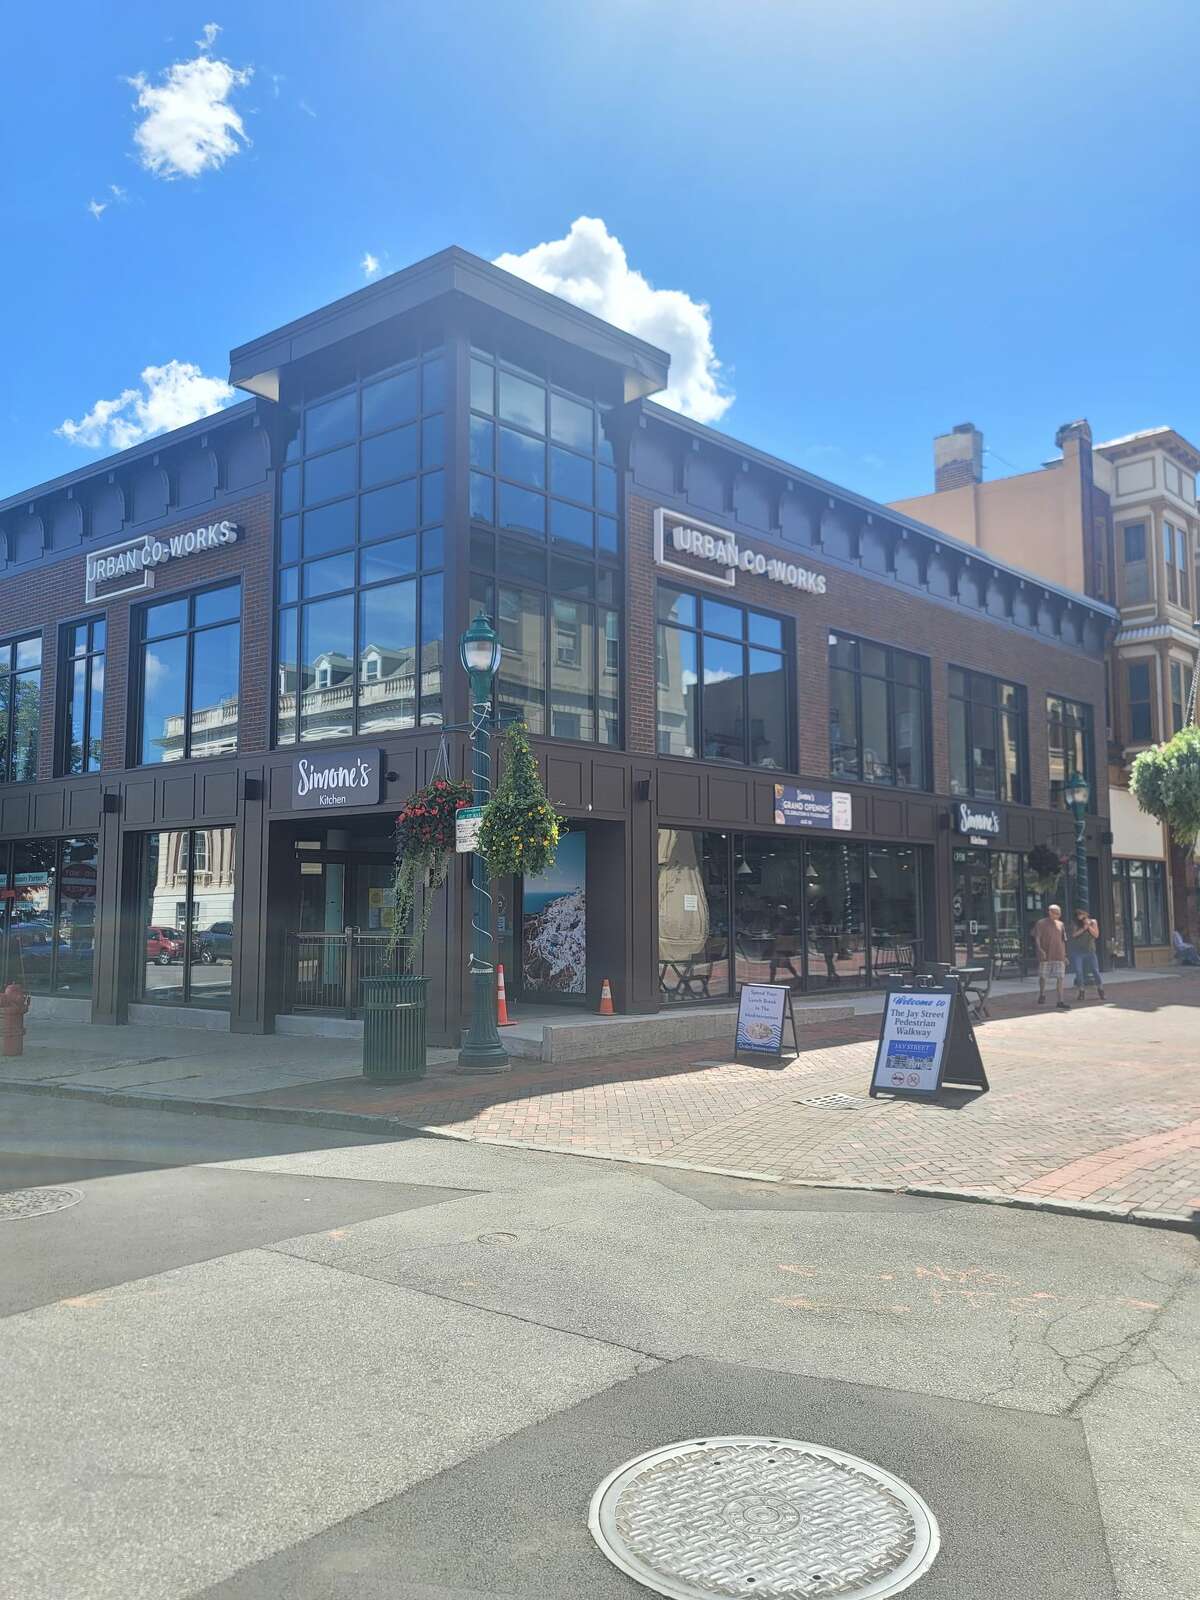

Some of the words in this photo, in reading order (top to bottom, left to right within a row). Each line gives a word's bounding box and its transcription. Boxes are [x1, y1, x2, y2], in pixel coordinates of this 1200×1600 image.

[86, 547, 139, 583] URBAN
[141, 519, 235, 566] CO-WORKS
[673, 526, 739, 567] URBAN
[742, 549, 827, 595] CO-WORKS
[297, 757, 372, 796] Simone's
[319, 793, 346, 806] Kitchen
[783, 801, 803, 810] GRAND
[804, 803, 830, 813] OPENING
[893, 996, 934, 1006] Welcome
[935, 999, 946, 1007] to
[891, 1008, 905, 1017] The
[906, 1009, 919, 1018] Jay
[921, 1009, 945, 1018] Street
[895, 1018, 936, 1027] Pedestrian
[896, 1027, 932, 1038] Walkway
